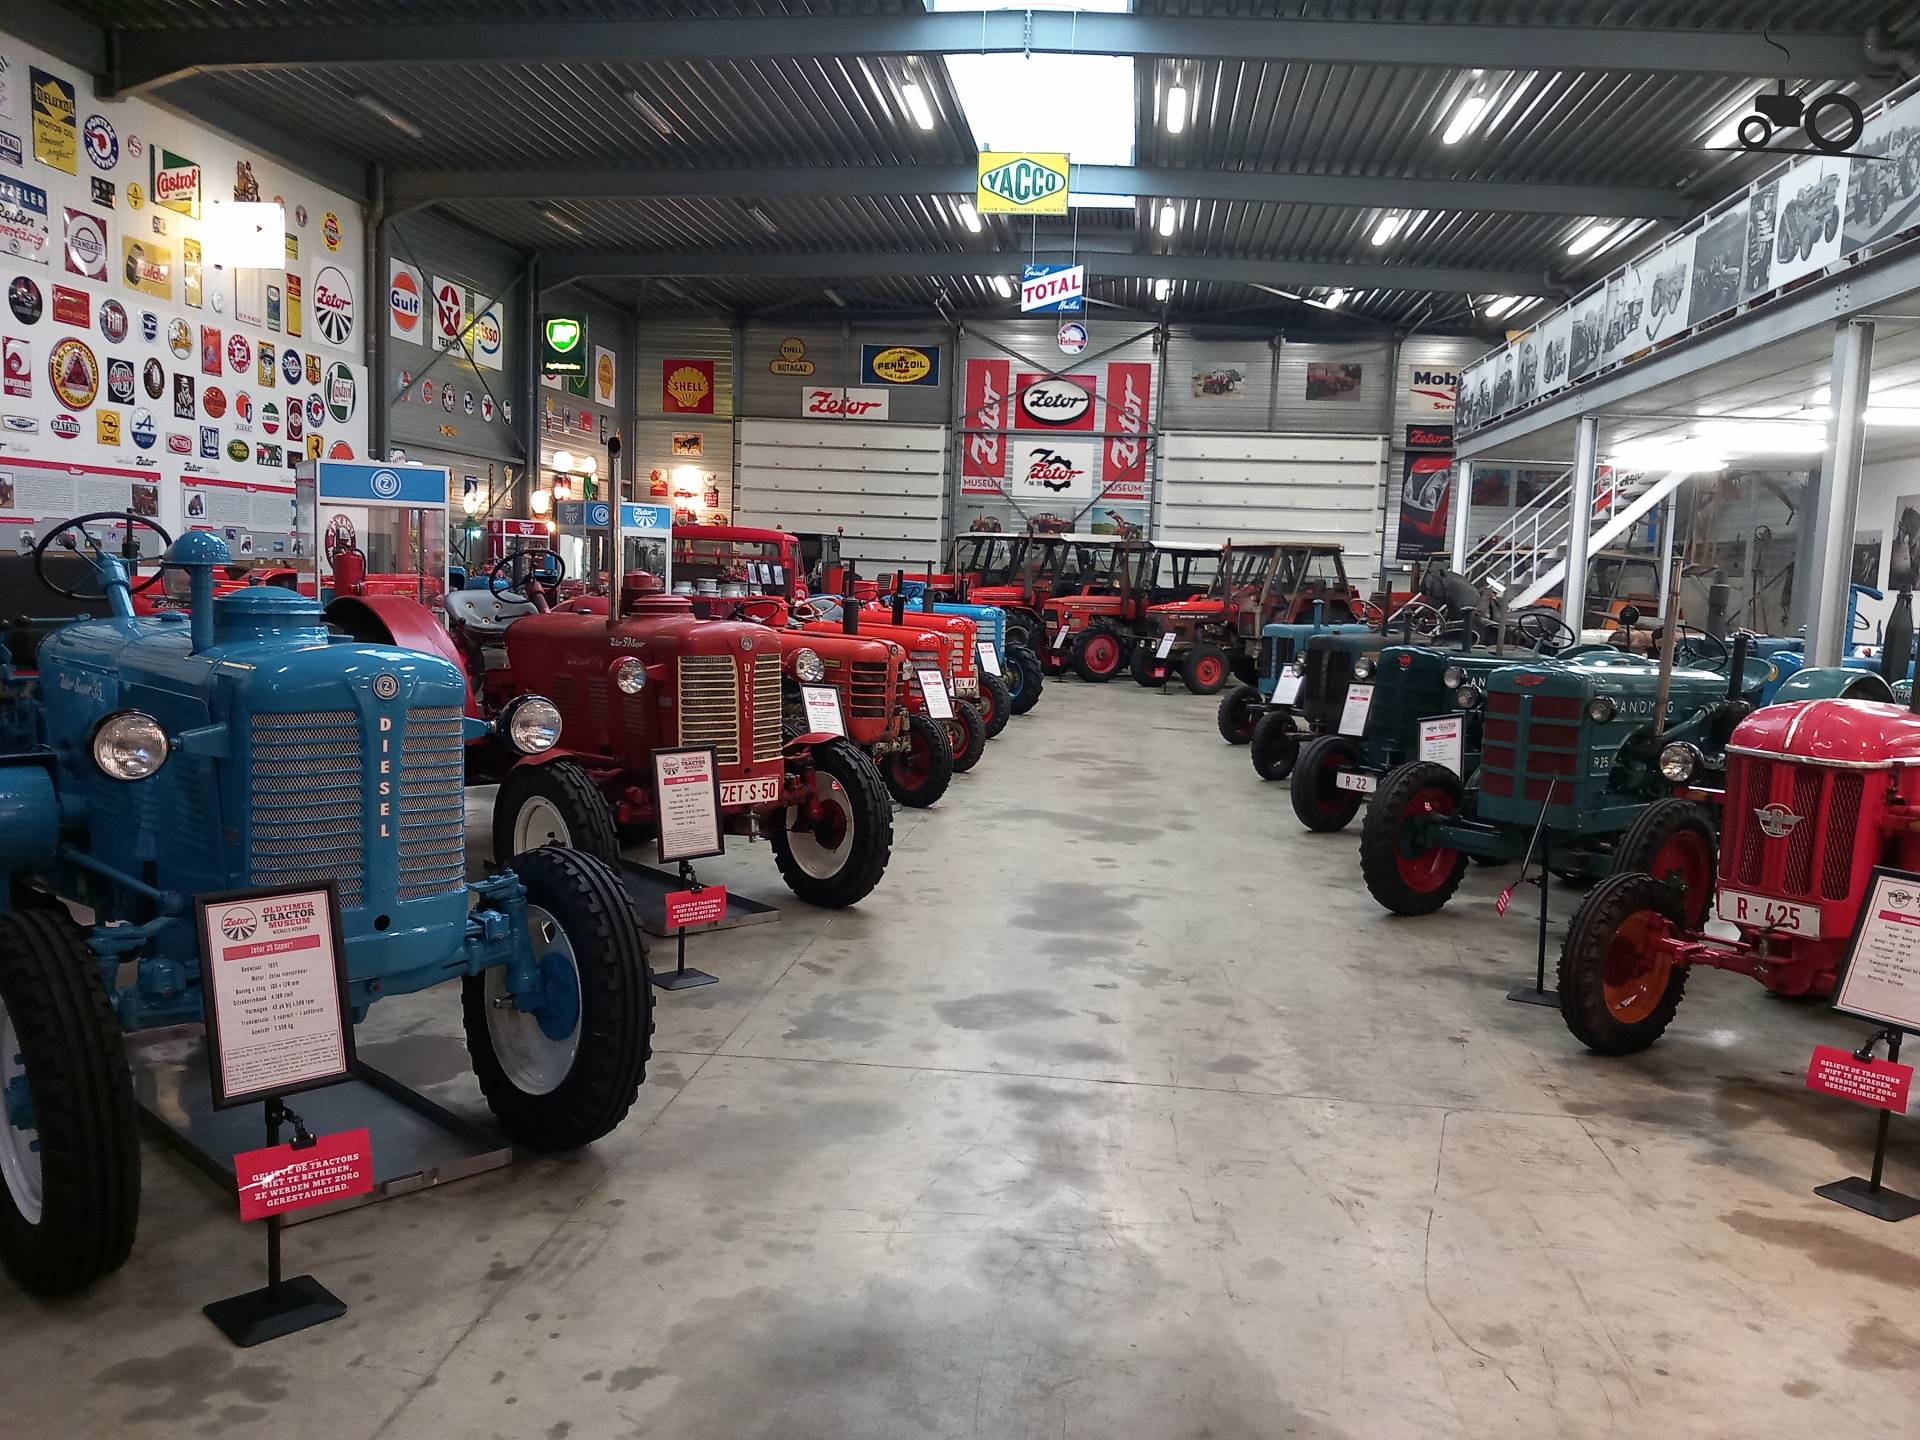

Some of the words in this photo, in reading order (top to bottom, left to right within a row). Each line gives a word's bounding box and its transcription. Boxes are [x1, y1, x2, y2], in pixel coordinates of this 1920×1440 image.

[37, 86, 74, 115] DELUXOL
[157, 169, 196, 198] Castrol
[988, 163, 1056, 200] YACCO
[1024, 274, 1081, 303] TOTAL
[317, 286, 351, 310] Zetor
[392, 290, 419, 313] Gulf
[877, 361, 926, 370] PENNZOIL
[673, 380, 703, 392] SHELL
[1414, 372, 1457, 385] Mob
[809, 391, 882, 415] Zetor
[1029, 390, 1088, 408] Zetor
[52, 422, 80, 432] DATSUN
[1111, 374, 1141, 469] Zetor
[1030, 463, 1084, 480] Zetor
[963, 478, 1001, 487] MUSEUM
[1104, 483, 1142, 492] MUSEUM
[1617, 700, 1673, 713] ANOMG
[379, 718, 392, 837] DIESEL
[261, 908, 316, 922] TRACTOR
[263, 901, 314, 914] OLDTIMER
[224, 917, 254, 928] Zetor
[268, 917, 311, 929] MUSEUM
[1820, 1060, 1850, 1071] GELIEVE
[1862, 1070, 1900, 1084] TRACTORS
[1825, 1067, 1841, 1076] NIET
[1829, 1075, 1858, 1087] WERDEN
[1859, 1082, 1876, 1092] MET
[1877, 1088, 1897, 1098] ZORG
[296, 1163, 308, 1173] DE
[309, 1153, 359, 1170] TRACTORS
[255, 1192, 267, 1200] ZE
[270, 1183, 310, 1197] WERDEN
[312, 1177, 332, 1187] MET
[335, 1172, 359, 1183] ZORG
[262, 1179, 285, 1190] NIET
[267, 1184, 349, 1207] GERESTAUREERD.
